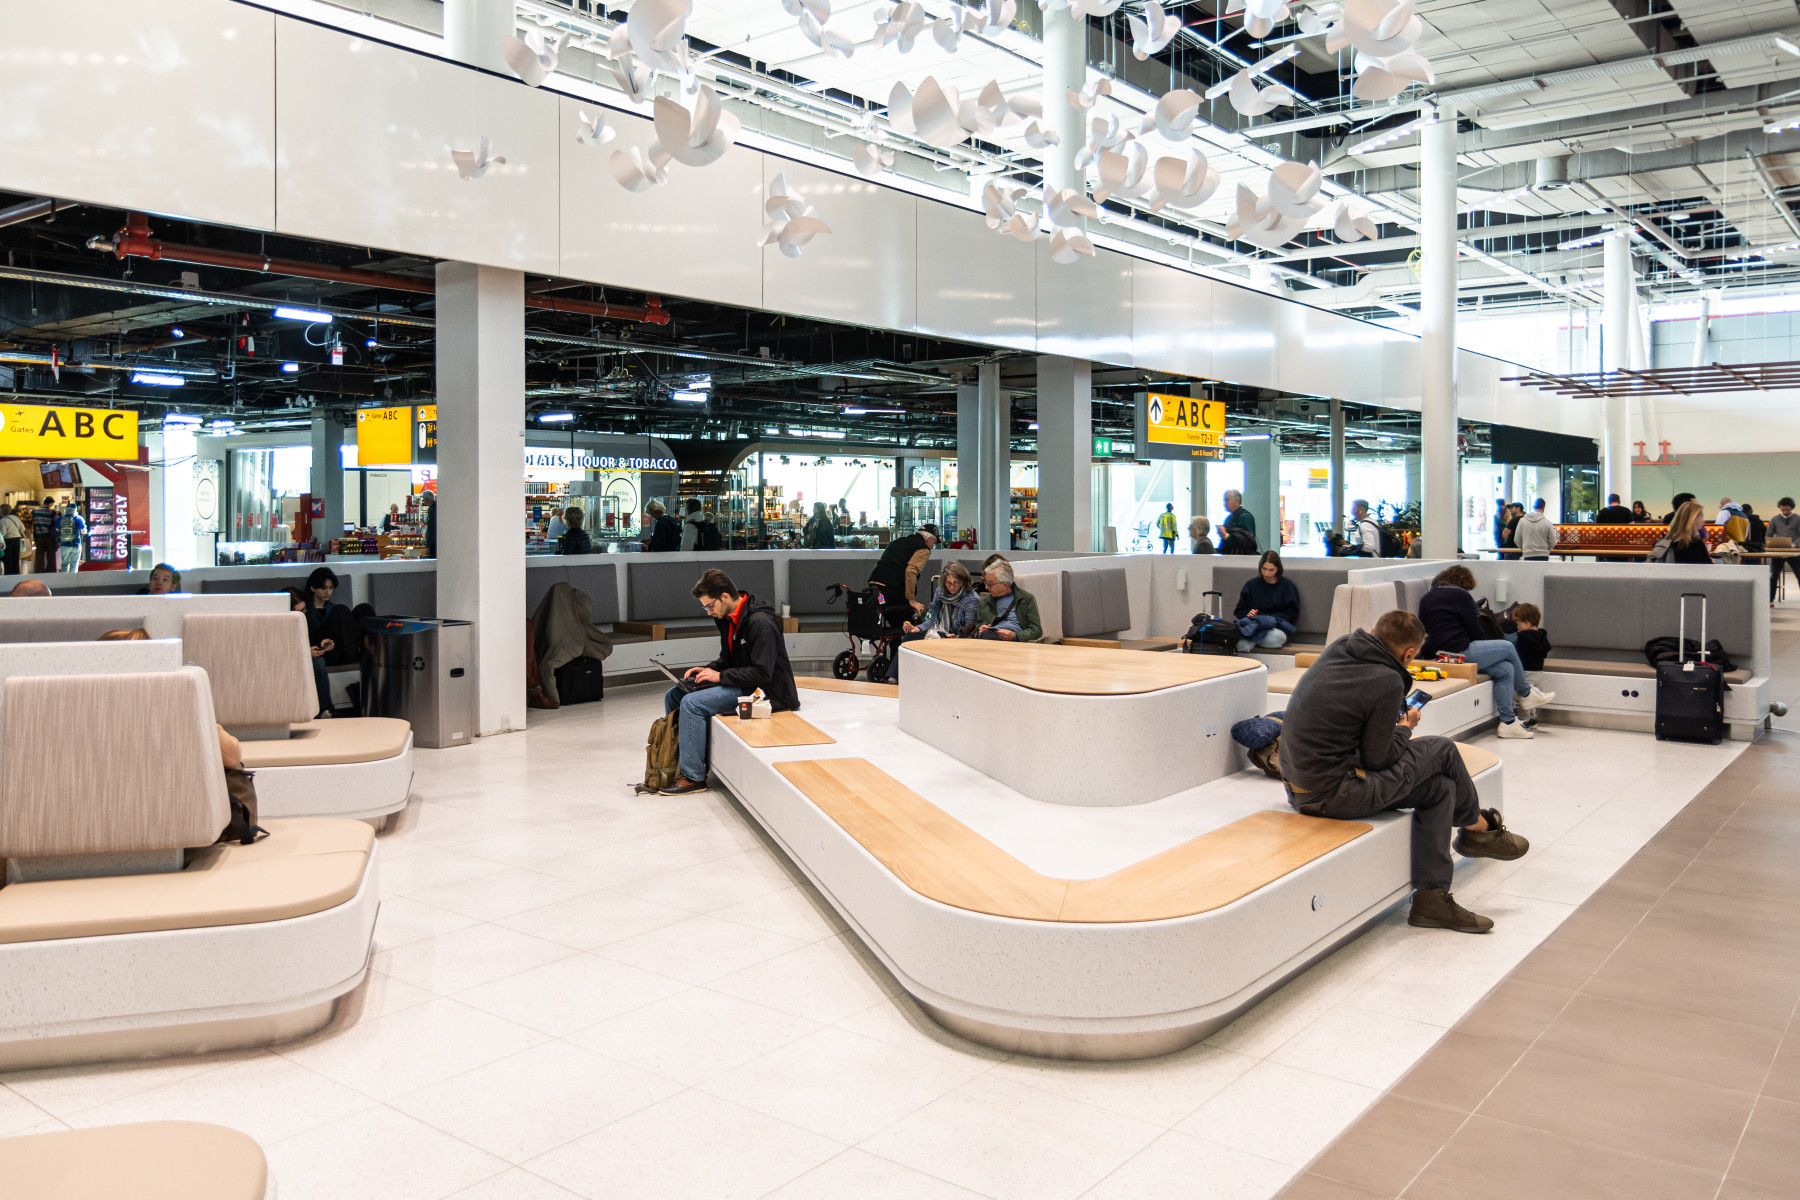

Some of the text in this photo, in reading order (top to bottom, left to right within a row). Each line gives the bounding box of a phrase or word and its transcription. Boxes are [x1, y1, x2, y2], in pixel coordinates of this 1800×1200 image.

[383, 410, 397, 420] ABC
[1176, 400, 1211, 429] ABC
[572, 456, 615, 469] LIQUOR
[618, 458, 626, 468] &
[629, 458, 677, 469] TOBACCO
[115, 493, 128, 559] GRAB&FLY
